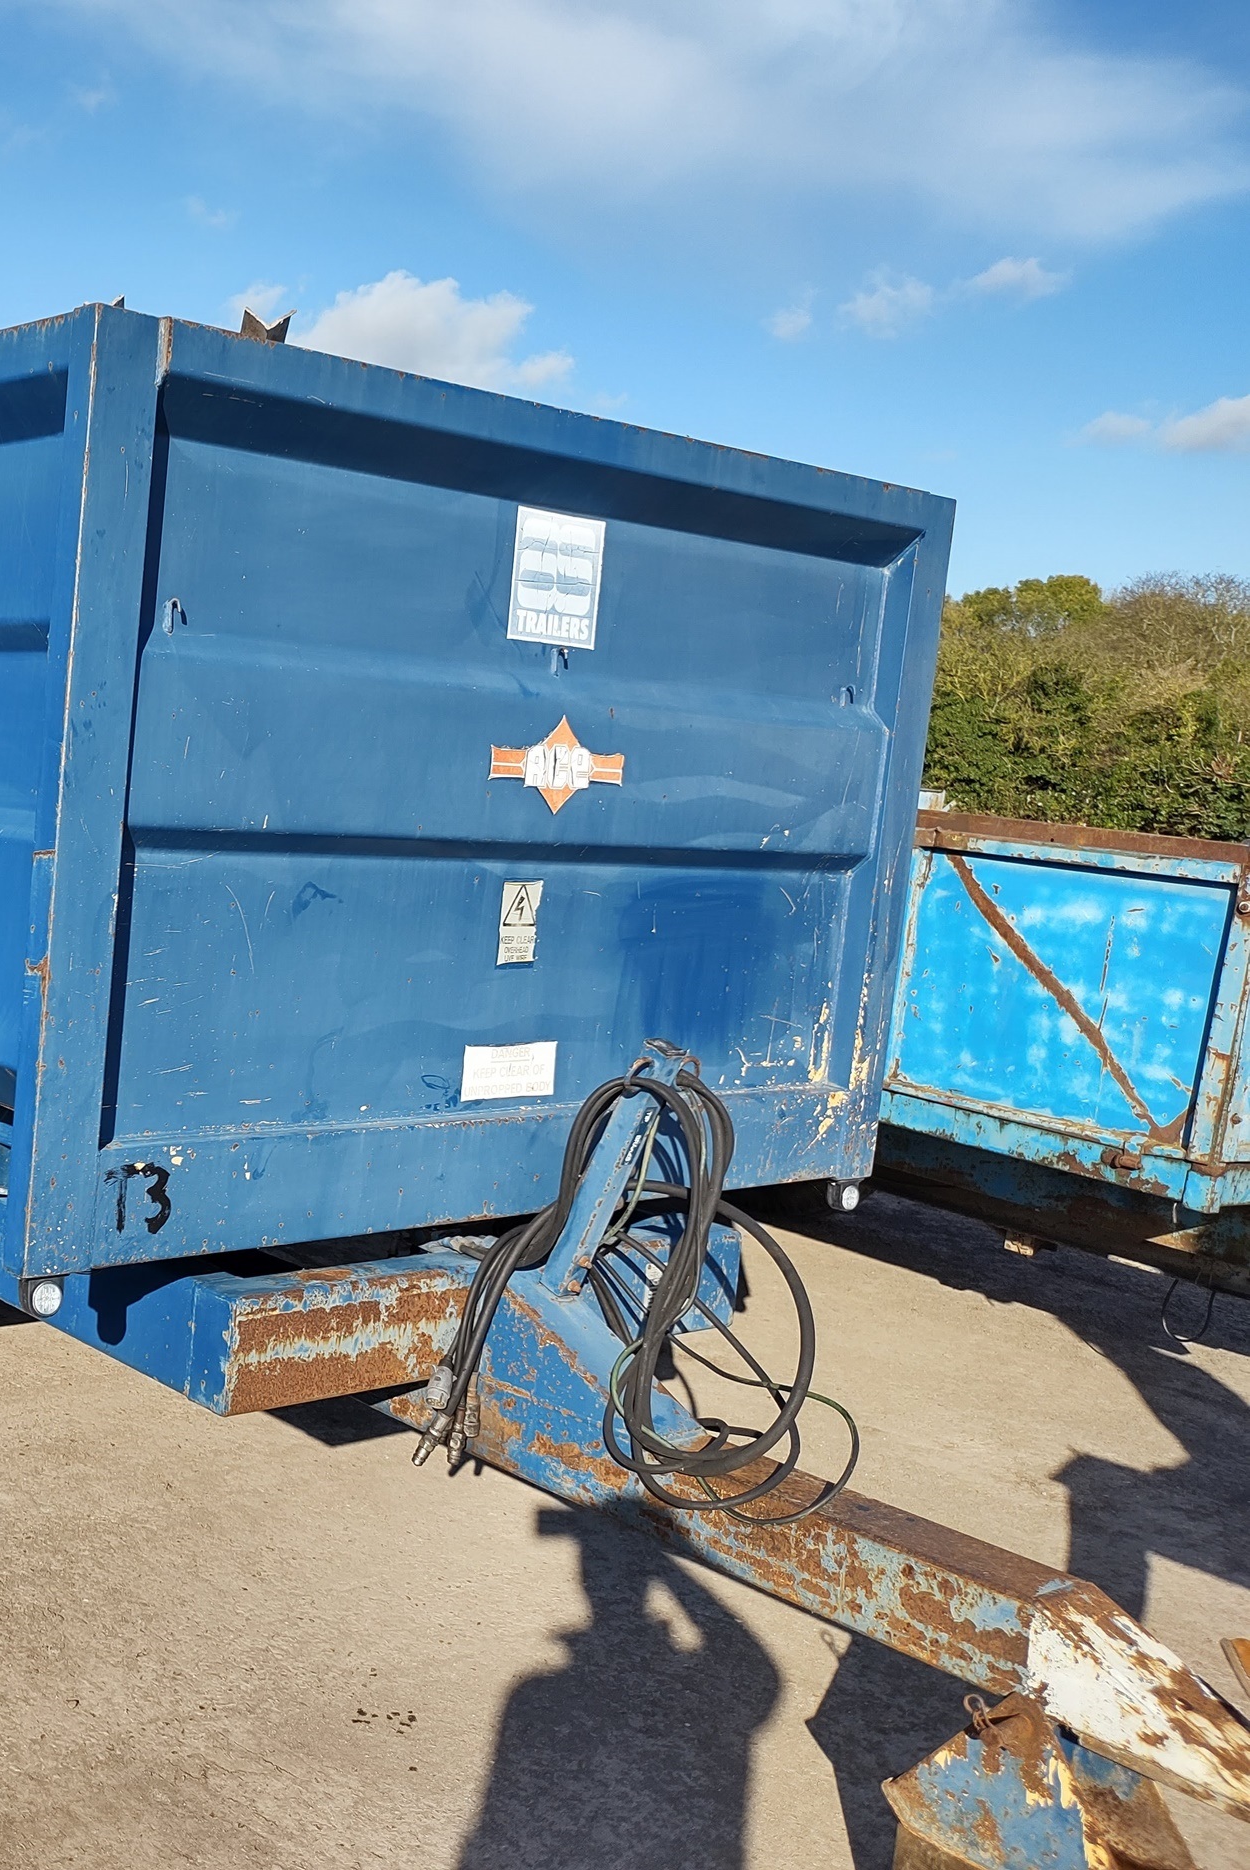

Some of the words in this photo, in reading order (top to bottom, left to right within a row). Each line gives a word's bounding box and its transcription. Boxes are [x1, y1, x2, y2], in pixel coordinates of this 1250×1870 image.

[516, 608, 590, 641] TRAILERS
[491, 1047, 530, 1059] DANGER
[473, 1067, 497, 1080] KEEP
[499, 1064, 530, 1078] CLEAR
[533, 1064, 545, 1075] OF
[463, 1083, 523, 1097] UNPROPPED
[104, 1162, 172, 1234] T3
